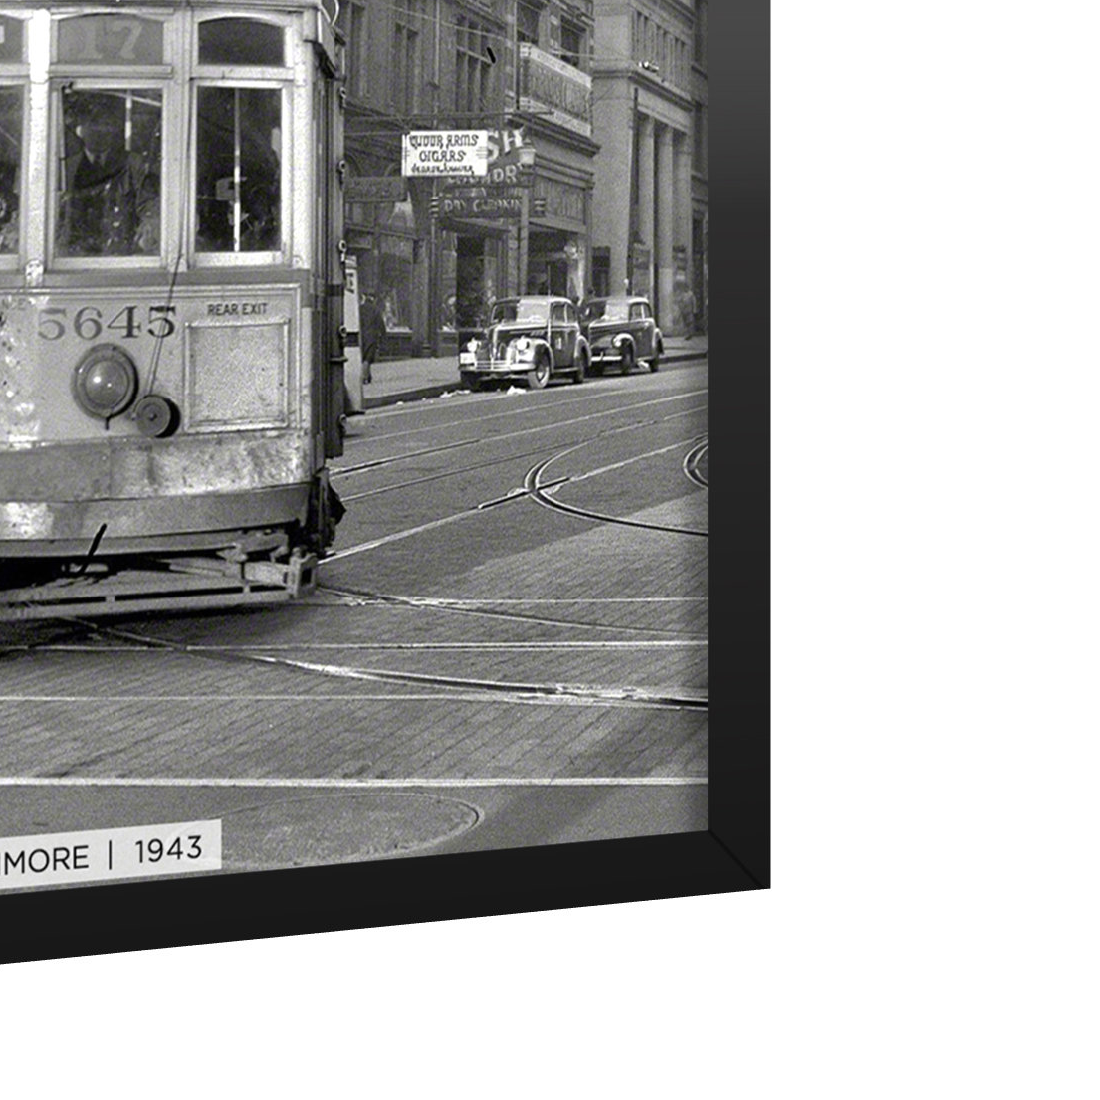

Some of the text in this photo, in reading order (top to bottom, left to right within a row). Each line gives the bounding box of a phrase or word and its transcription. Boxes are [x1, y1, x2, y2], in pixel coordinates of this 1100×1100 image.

[76, 19, 143, 59] 17
[445, 134, 479, 150] ARMS
[419, 150, 467, 162] CIGARS
[206, 302, 268, 316] REAR EXIT
[37, 305, 177, 341] 5645
